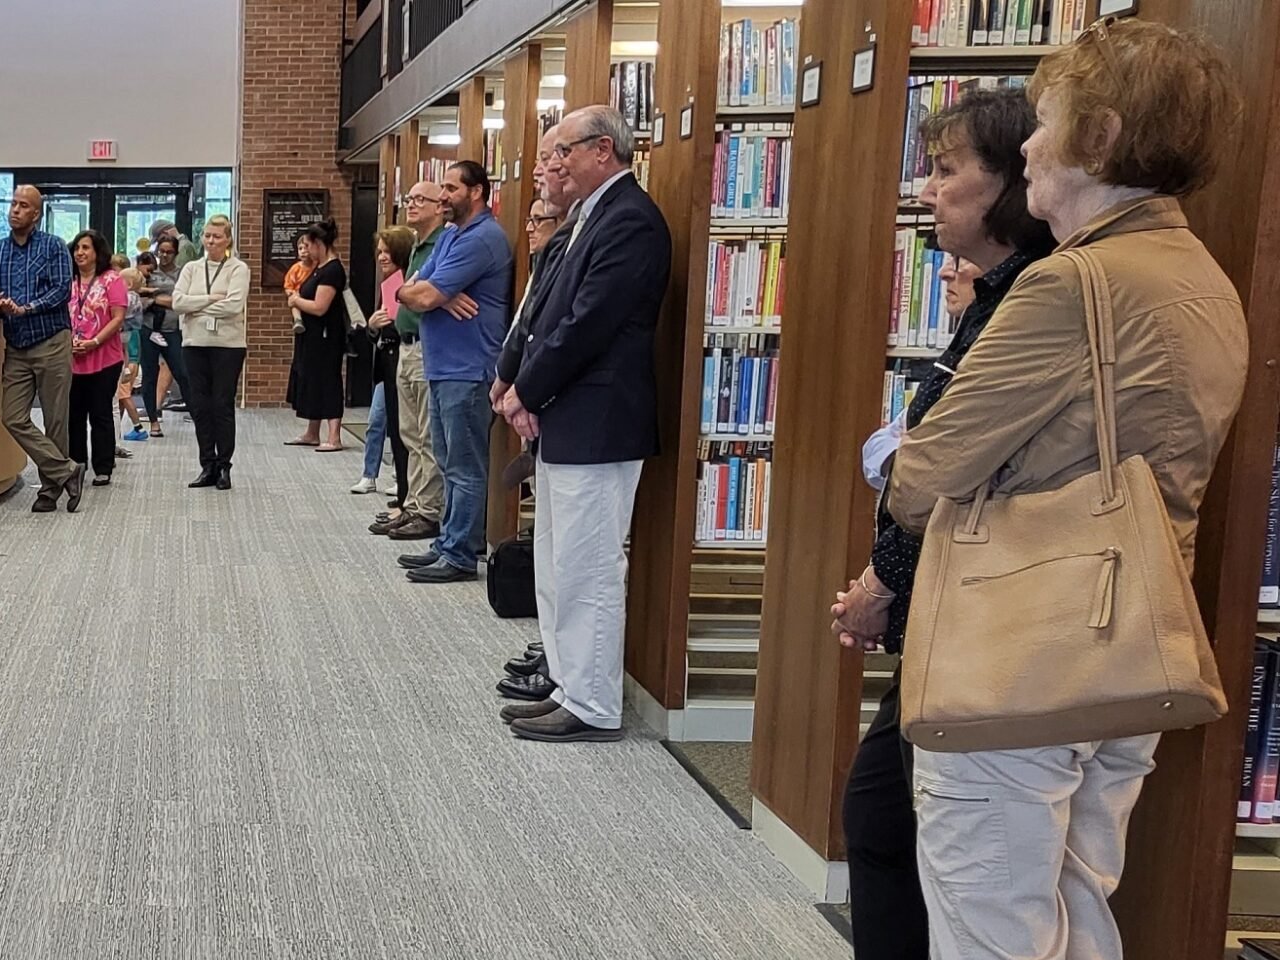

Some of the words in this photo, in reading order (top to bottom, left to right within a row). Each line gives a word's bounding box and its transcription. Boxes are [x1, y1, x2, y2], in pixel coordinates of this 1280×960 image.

[92, 141, 113, 157] EXIT
[729, 150, 738, 181] RAISING
[727, 181, 736, 208] GIRLS
[900, 276, 911, 313] DIABETES
[1271, 470, 1280, 487] The
[1270, 488, 1280, 505] Sky
[1267, 518, 1277, 532] for
[1269, 508, 1279, 516] Is
[1264, 533, 1277, 575] Everyone
[1251, 666, 1264, 704] UNTIL
[1248, 706, 1260, 731] THE
[1242, 757, 1253, 787] BRIAN
